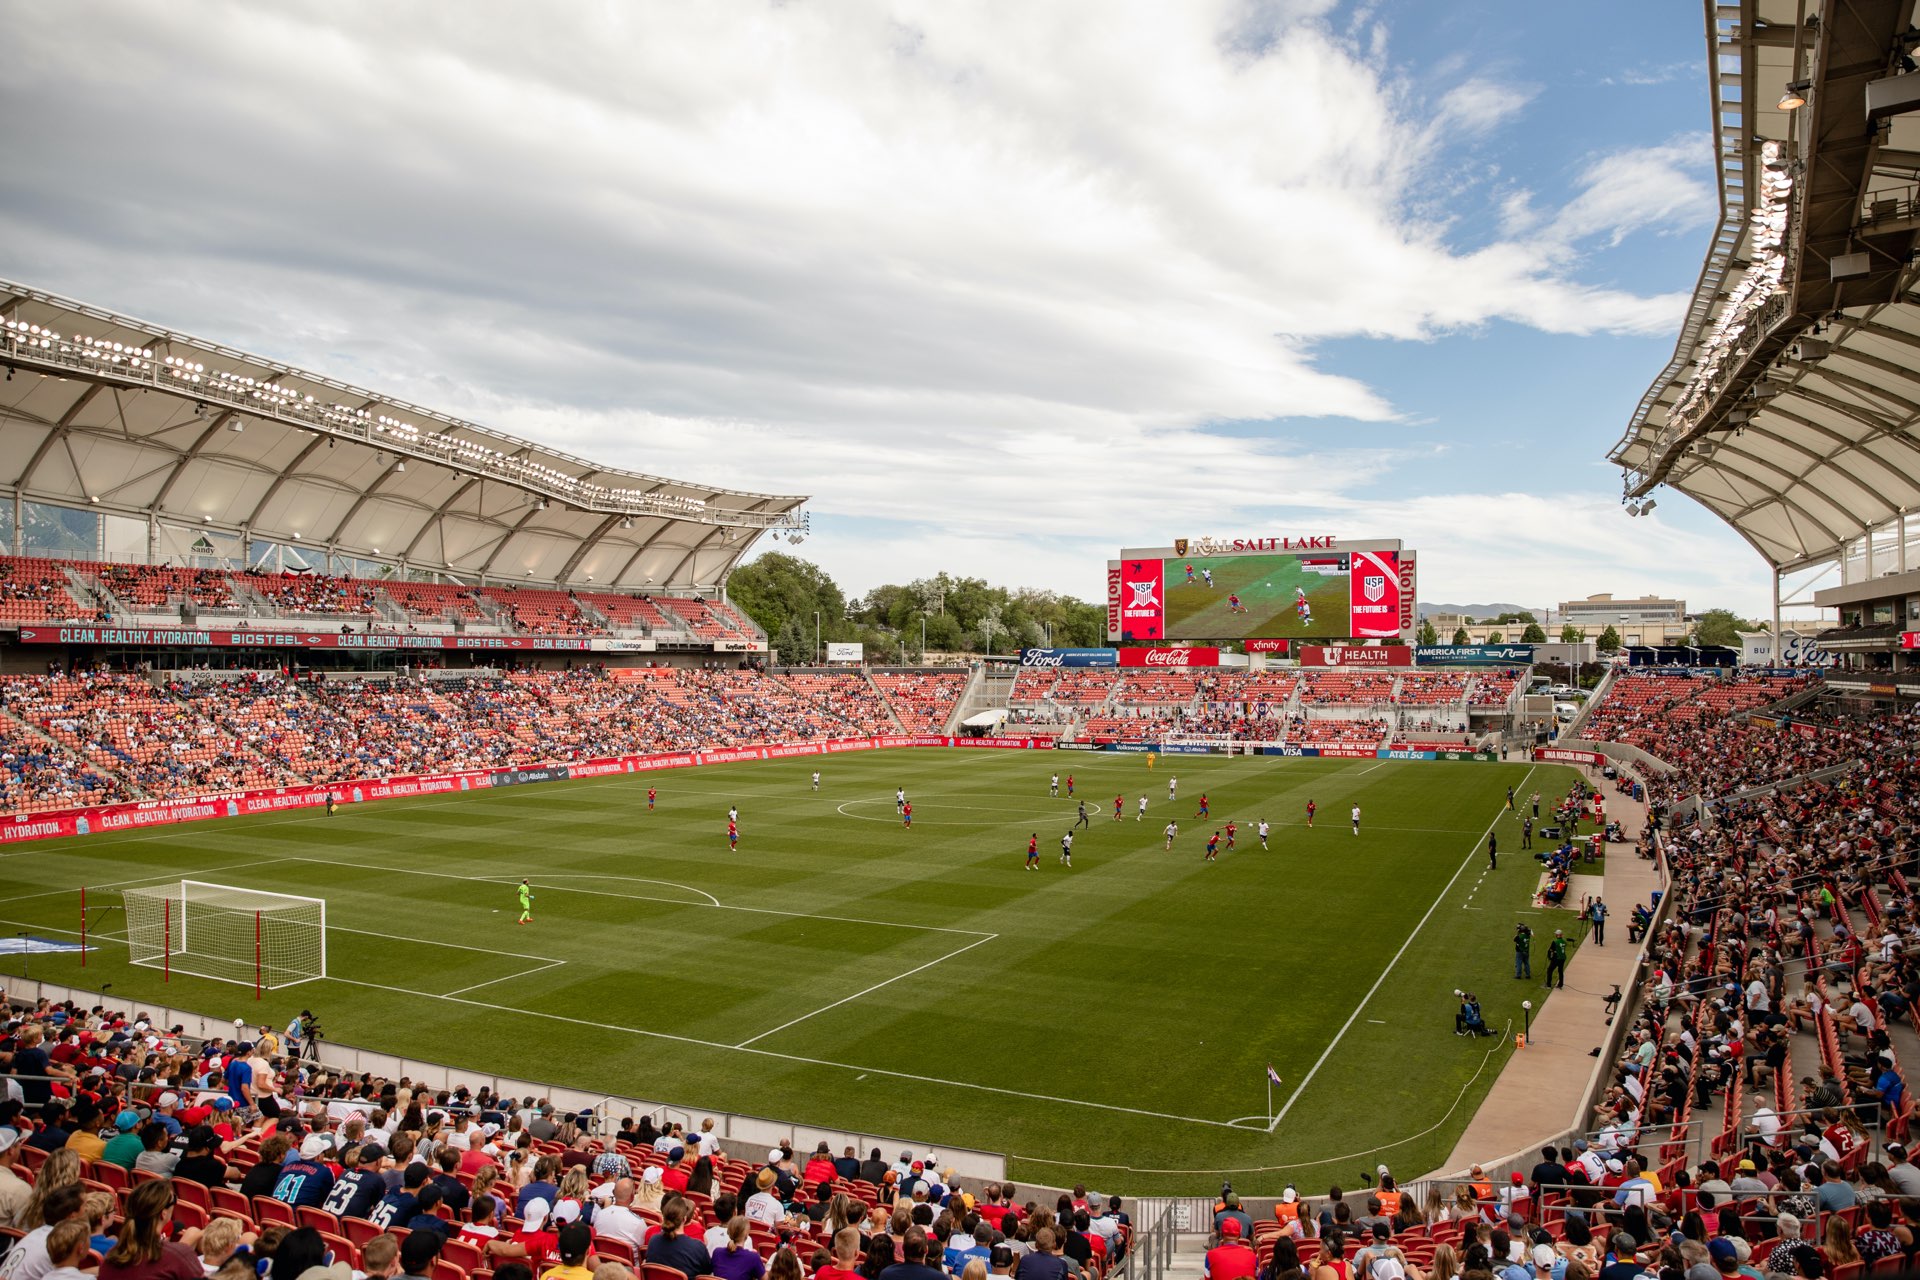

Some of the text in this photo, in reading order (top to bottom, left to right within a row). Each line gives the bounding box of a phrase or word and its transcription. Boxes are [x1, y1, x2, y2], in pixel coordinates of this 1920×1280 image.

[1232, 538, 1280, 551] SALT
[1284, 536, 1336, 550] LAKE
[191, 546, 215, 555] Sandy
[1136, 584, 1151, 593] USA
[1366, 578, 1383, 587] USA
[60, 629, 212, 645] CLEAN. HEALTHY. HYDRATION.
[232, 634, 303, 645] BIOSTEEL
[338, 635, 444, 648] CLEAN. HEALTHY. HYDRATION.
[457, 639, 508, 647] BIOSTEEL
[533, 639, 554, 649] CLEAN.
[556, 639, 584, 650] HEALTHY.
[725, 643, 746, 651] KeyBank
[1253, 640, 1279, 650] xfinity
[1023, 648, 1064, 666] Ford
[1145, 649, 1191, 665] Coca-Cola
[1345, 651, 1388, 660] HEALTH
[529, 772, 548, 780] Allstate
[371, 780, 453, 797] CLEAN. HEALTHY. HYDRATION.
[248, 791, 344, 810] CLEAN. HEALTHY. HYDRAON.
[102, 805, 217, 828] CLEAN. HEALTHY. HYDRATION.
[4, 822, 62, 839] HYDRATION.
[272, 1174, 306, 1204] 41
[322, 1179, 358, 1216] 23
